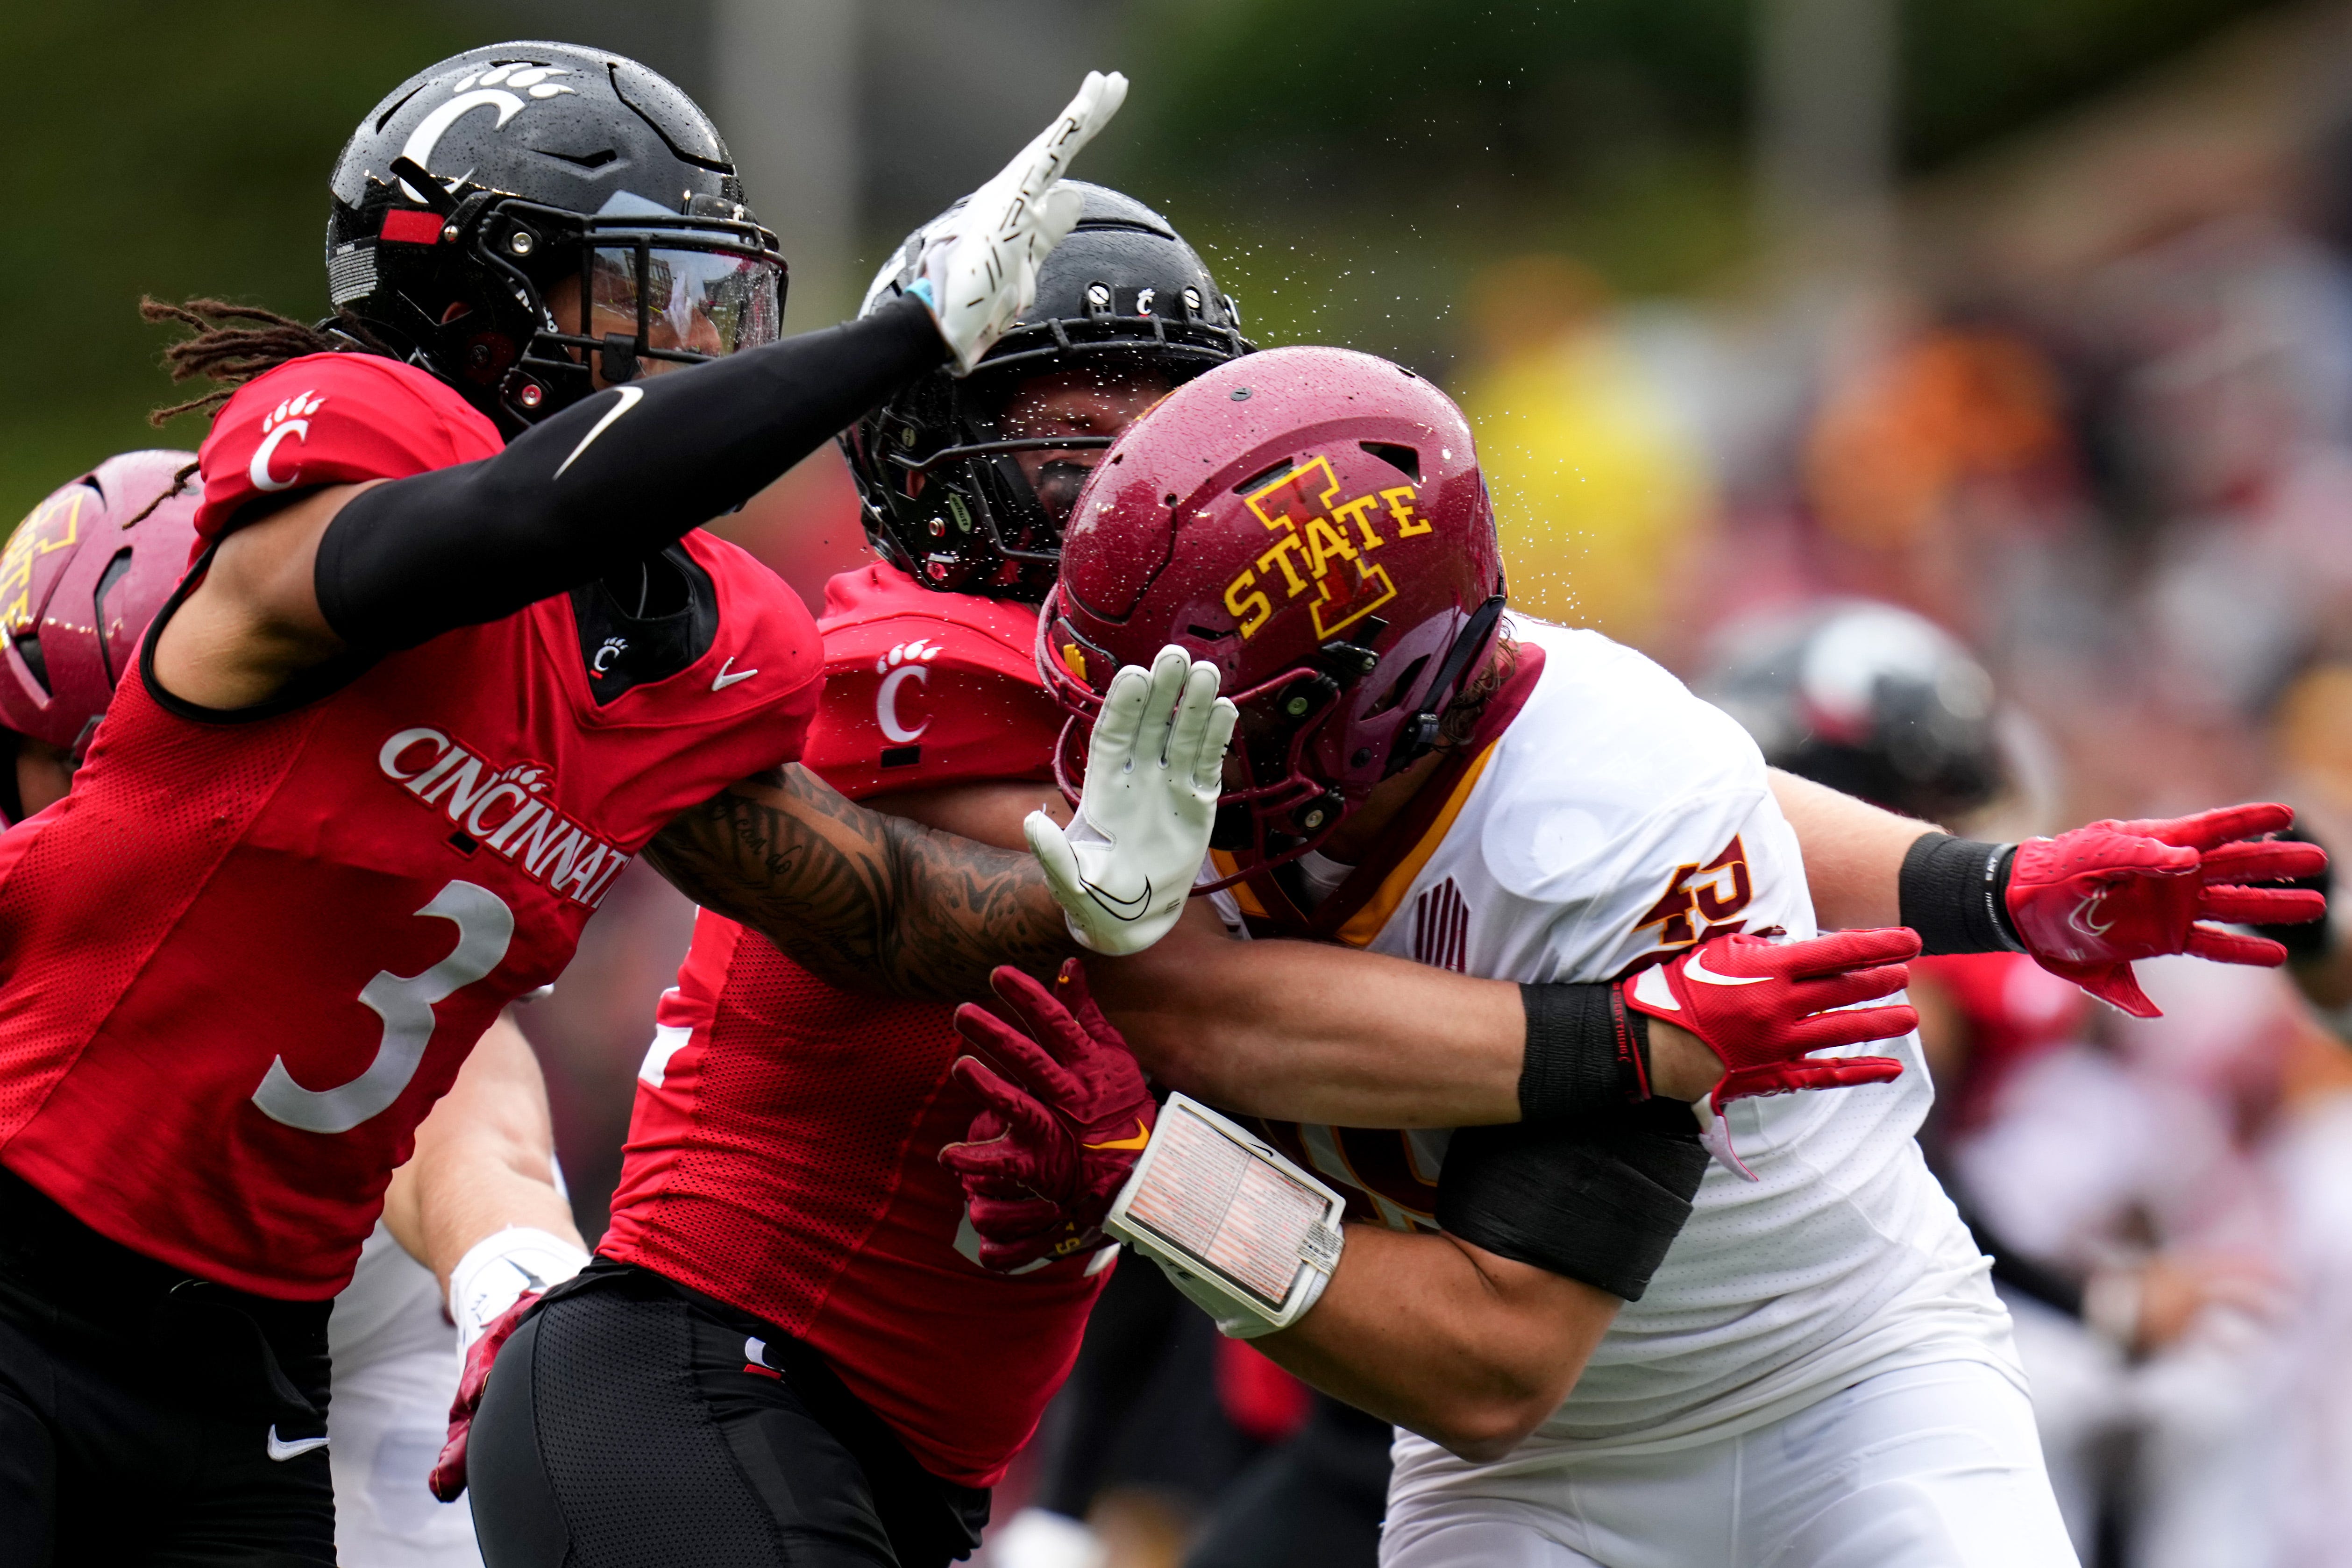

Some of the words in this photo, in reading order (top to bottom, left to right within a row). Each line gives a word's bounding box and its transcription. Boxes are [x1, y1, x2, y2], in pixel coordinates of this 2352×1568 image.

[1223, 485, 1433, 640] STATE
[876, 665, 931, 743] C
[251, 879, 515, 1134] 3
[1612, 991, 1629, 1055] EVERYTHING
